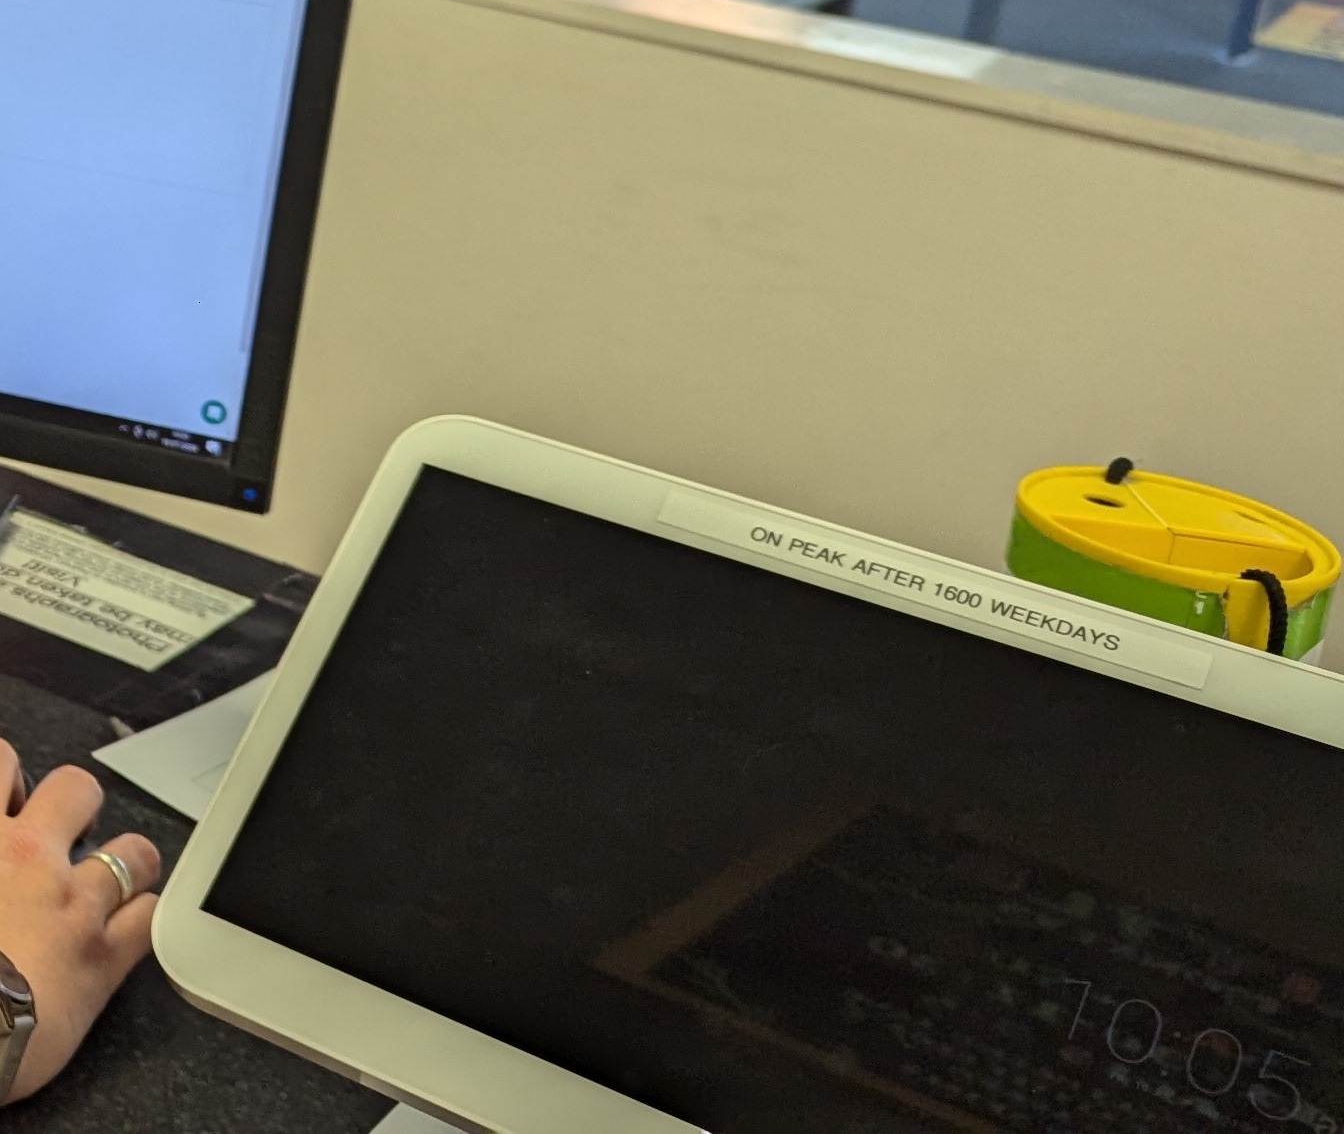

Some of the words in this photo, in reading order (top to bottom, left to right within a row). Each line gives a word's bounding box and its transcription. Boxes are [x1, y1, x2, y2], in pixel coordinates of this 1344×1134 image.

[750, 526, 783, 547] ON
[788, 538, 846, 567] PEAK
[851, 559, 925, 592] AFTER
[934, 583, 982, 608] 1600
[990, 598, 1121, 651] WEEKDAYS
[1064, 978, 1312, 1120] 10:05
